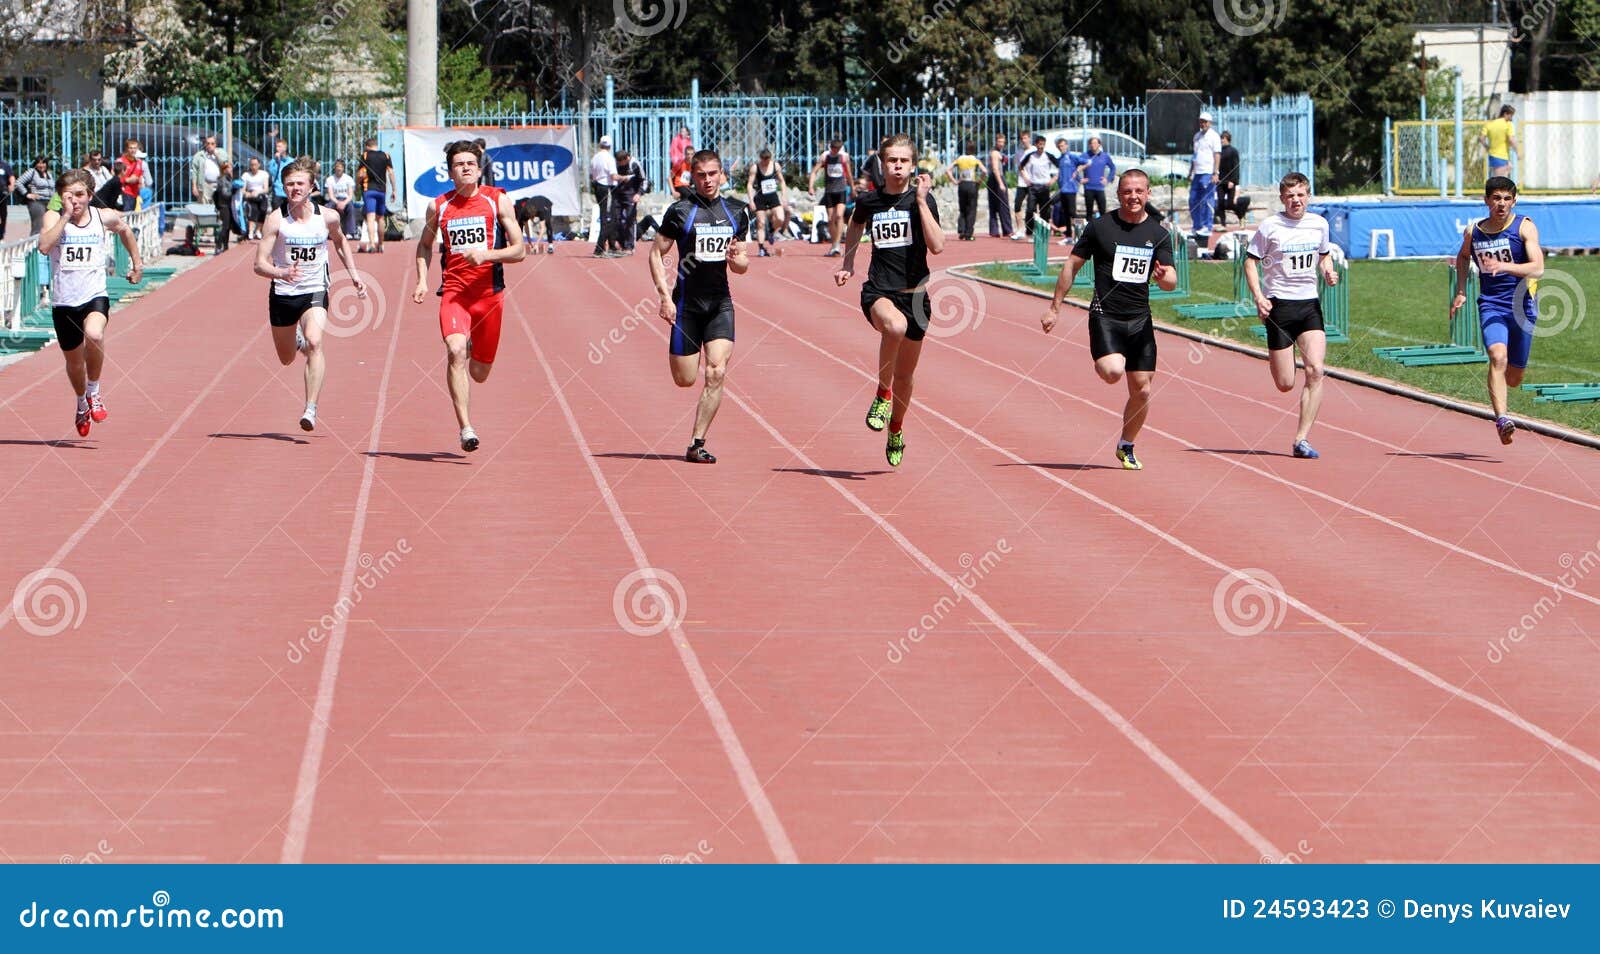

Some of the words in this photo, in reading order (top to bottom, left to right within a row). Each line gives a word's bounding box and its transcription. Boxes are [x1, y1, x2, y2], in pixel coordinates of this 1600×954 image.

[435, 160, 555, 182] SSUNG
[449, 227, 486, 246] 2353
[874, 222, 908, 240] 1597
[66, 247, 92, 262] 547
[290, 247, 316, 262] 543
[1289, 253, 1313, 270] 110
[1122, 257, 1147, 275] 755
